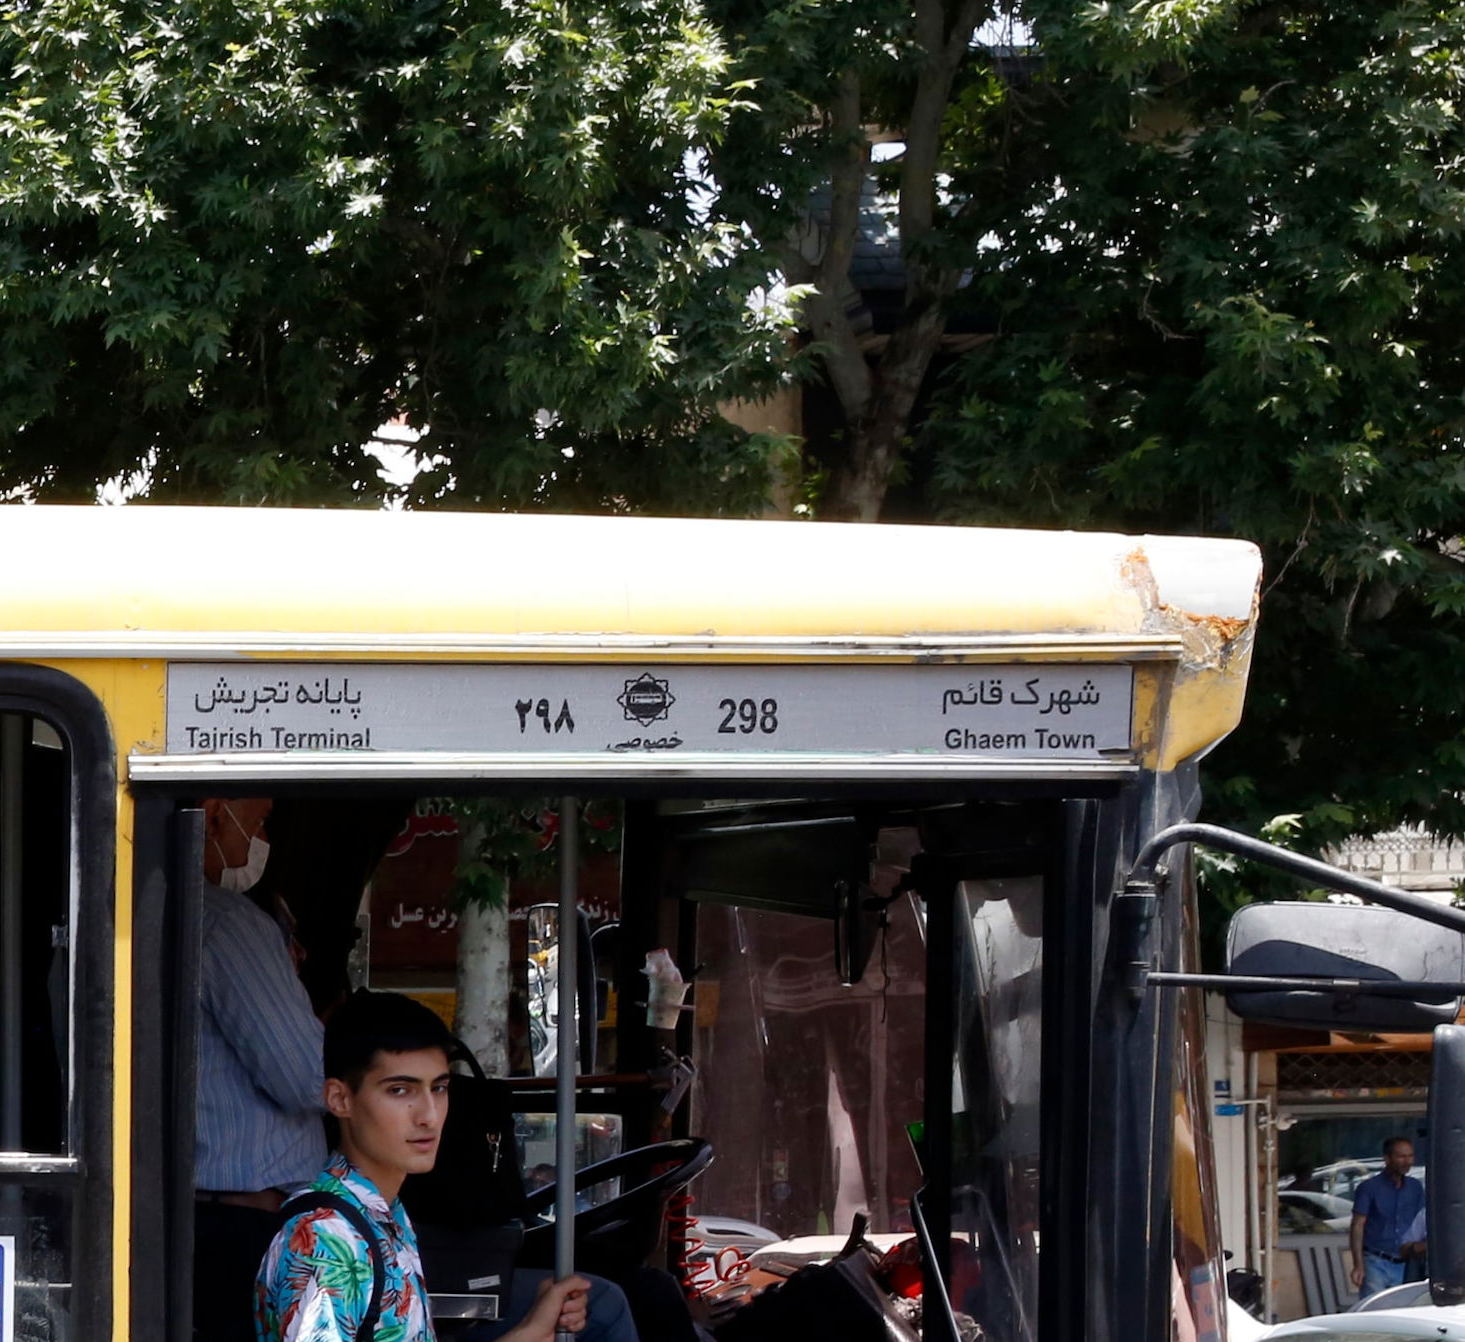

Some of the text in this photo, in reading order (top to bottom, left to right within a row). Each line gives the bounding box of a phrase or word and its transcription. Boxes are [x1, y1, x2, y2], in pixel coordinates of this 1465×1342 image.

[194, 677, 362, 720] پایانه تجریش
[942, 678, 1100, 715] شهرک قائم
[514, 698, 575, 734] ۲۹۸
[717, 698, 778, 734] 298
[185, 727, 370, 750] Tajrish Terminal
[944, 728, 1096, 749] Ghaem Town
